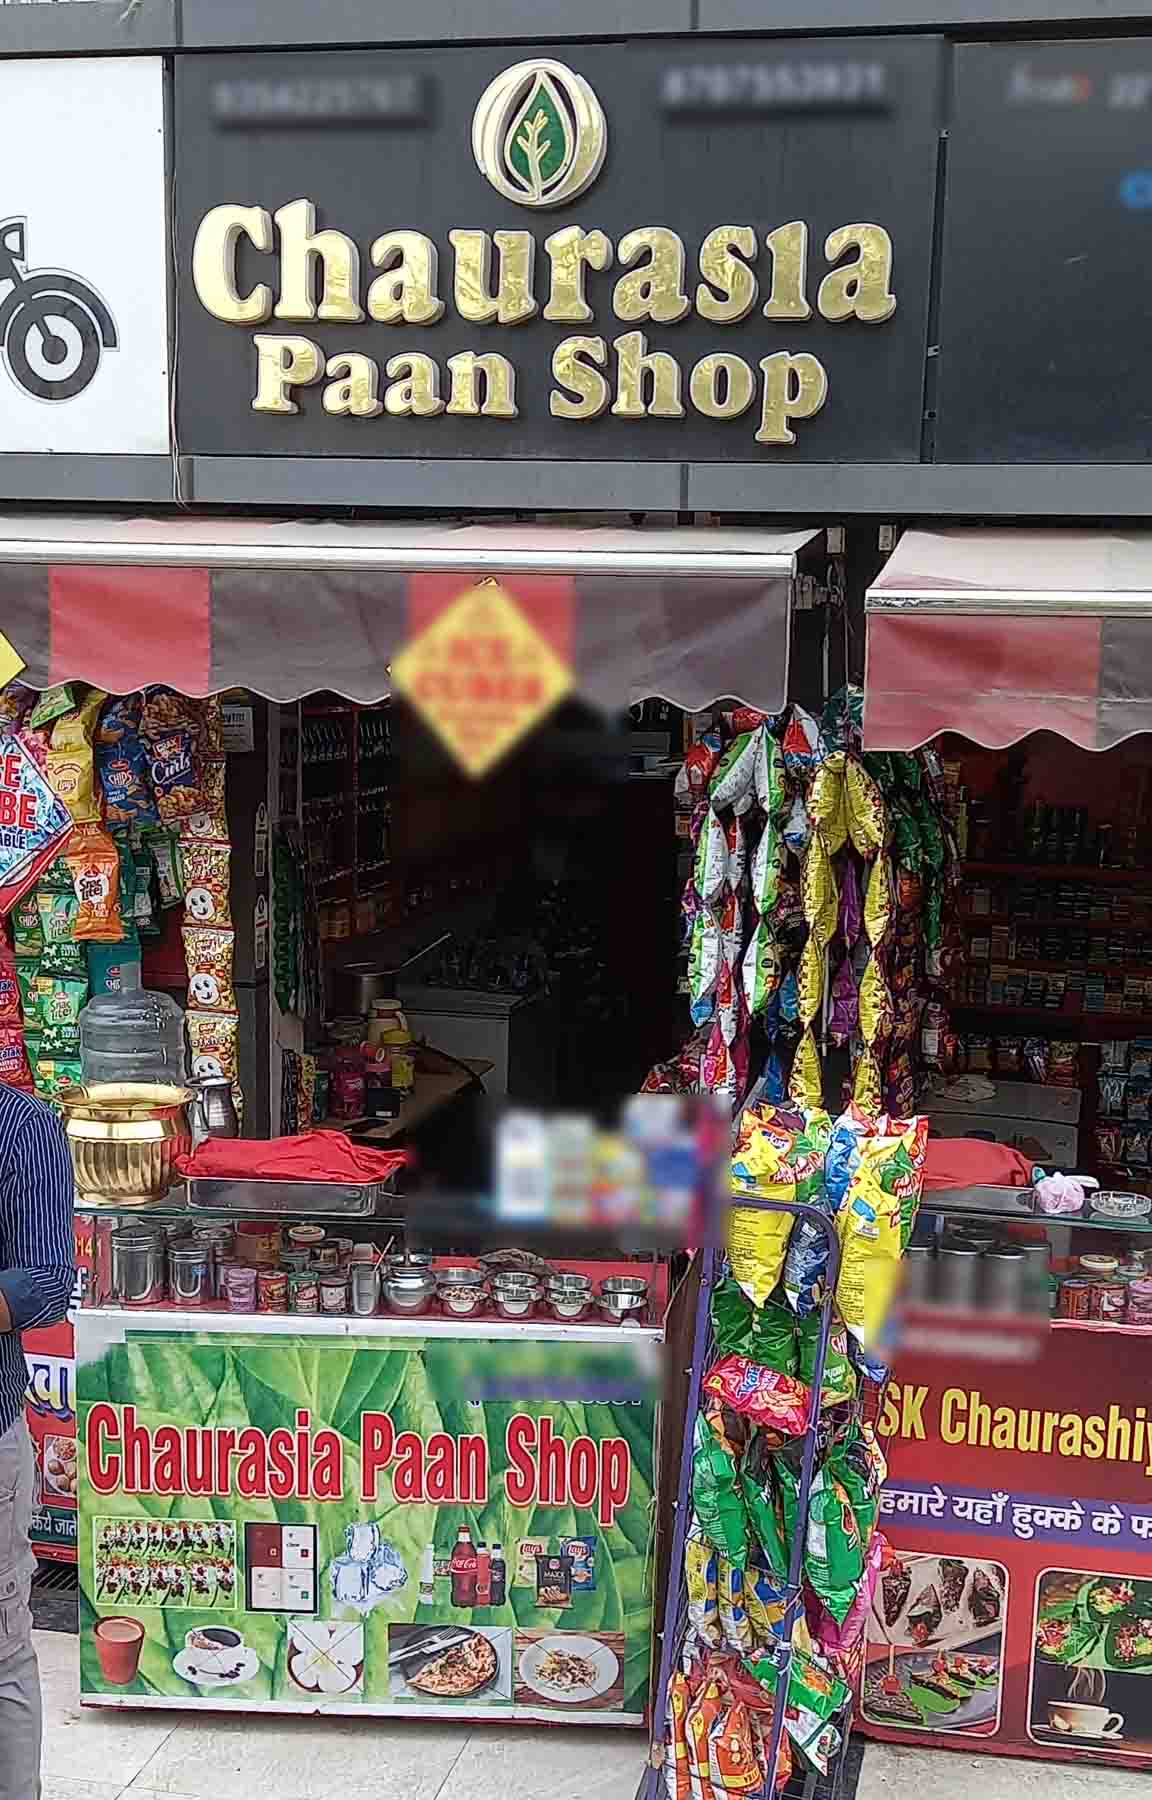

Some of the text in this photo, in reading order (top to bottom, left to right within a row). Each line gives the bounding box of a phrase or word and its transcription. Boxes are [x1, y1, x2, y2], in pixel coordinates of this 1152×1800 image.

[192, 199, 898, 326] Chaurasia
[252, 331, 828, 446] Paan Shop
[0, 753, 21, 789] E
[86, 1401, 343, 1501] Chaurasia
[360, 1410, 488, 1504] Paan
[504, 1413, 631, 1528] Shop
[877, 1381, 1152, 1477] SK Chaurashi
[879, 1485, 948, 1518] हमारे
[952, 1491, 1010, 1525] यहाँ
[1091, 1504, 1124, 1536] के
